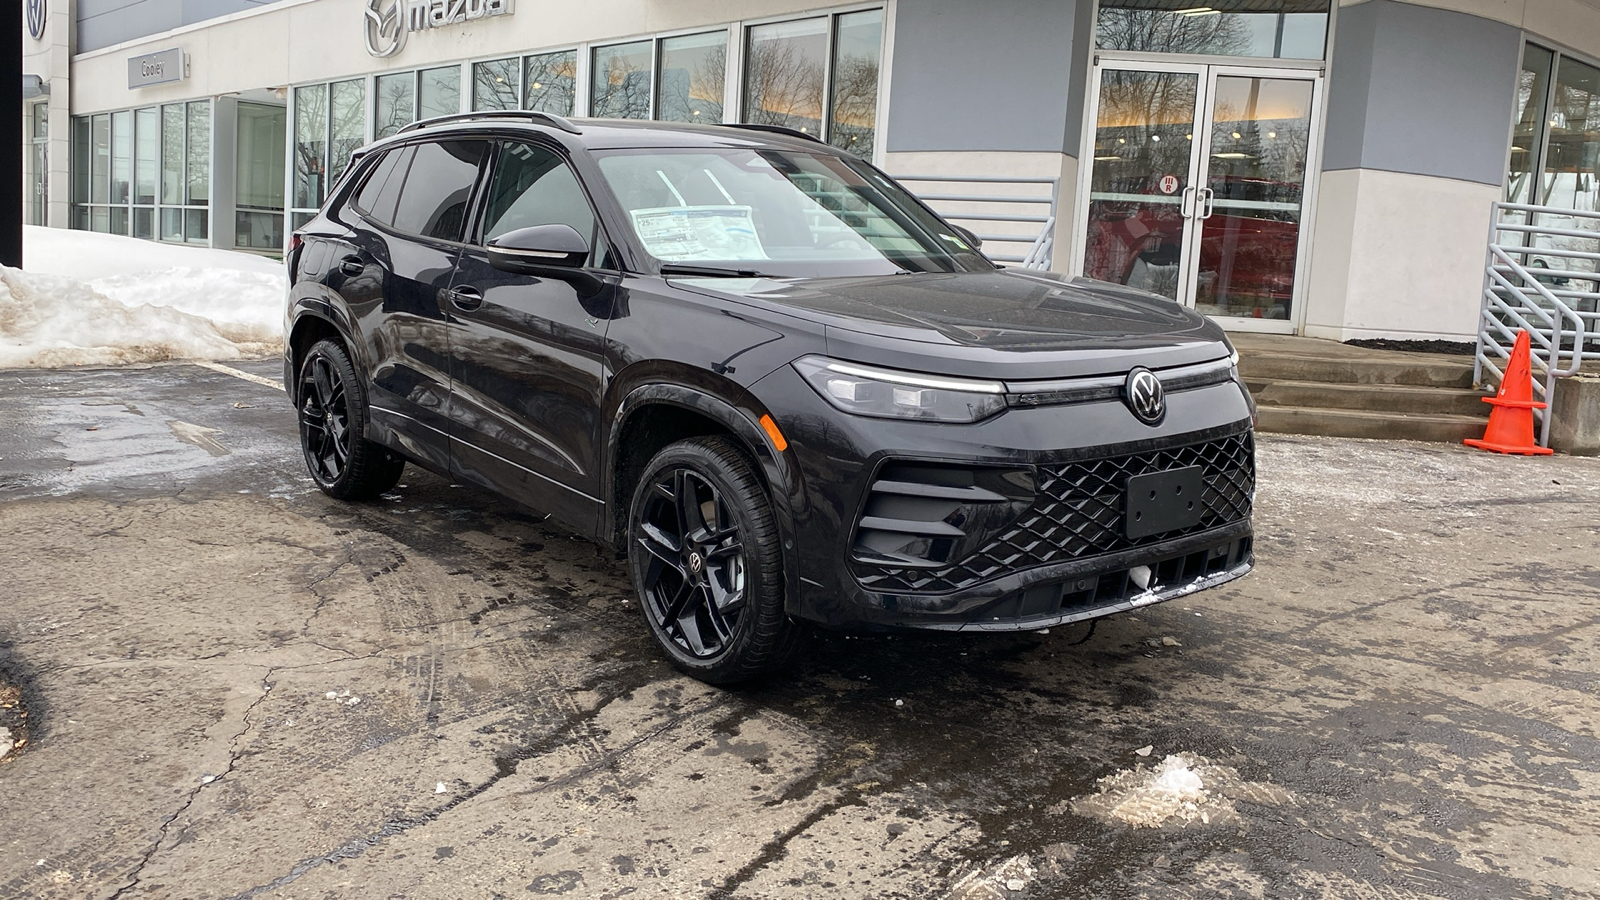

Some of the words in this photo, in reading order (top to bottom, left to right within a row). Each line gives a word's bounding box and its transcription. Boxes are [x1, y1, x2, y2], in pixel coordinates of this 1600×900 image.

[407, 0, 507, 32] mazda
[141, 56, 165, 79] Cooley
[1132, 371, 1163, 420] VW
